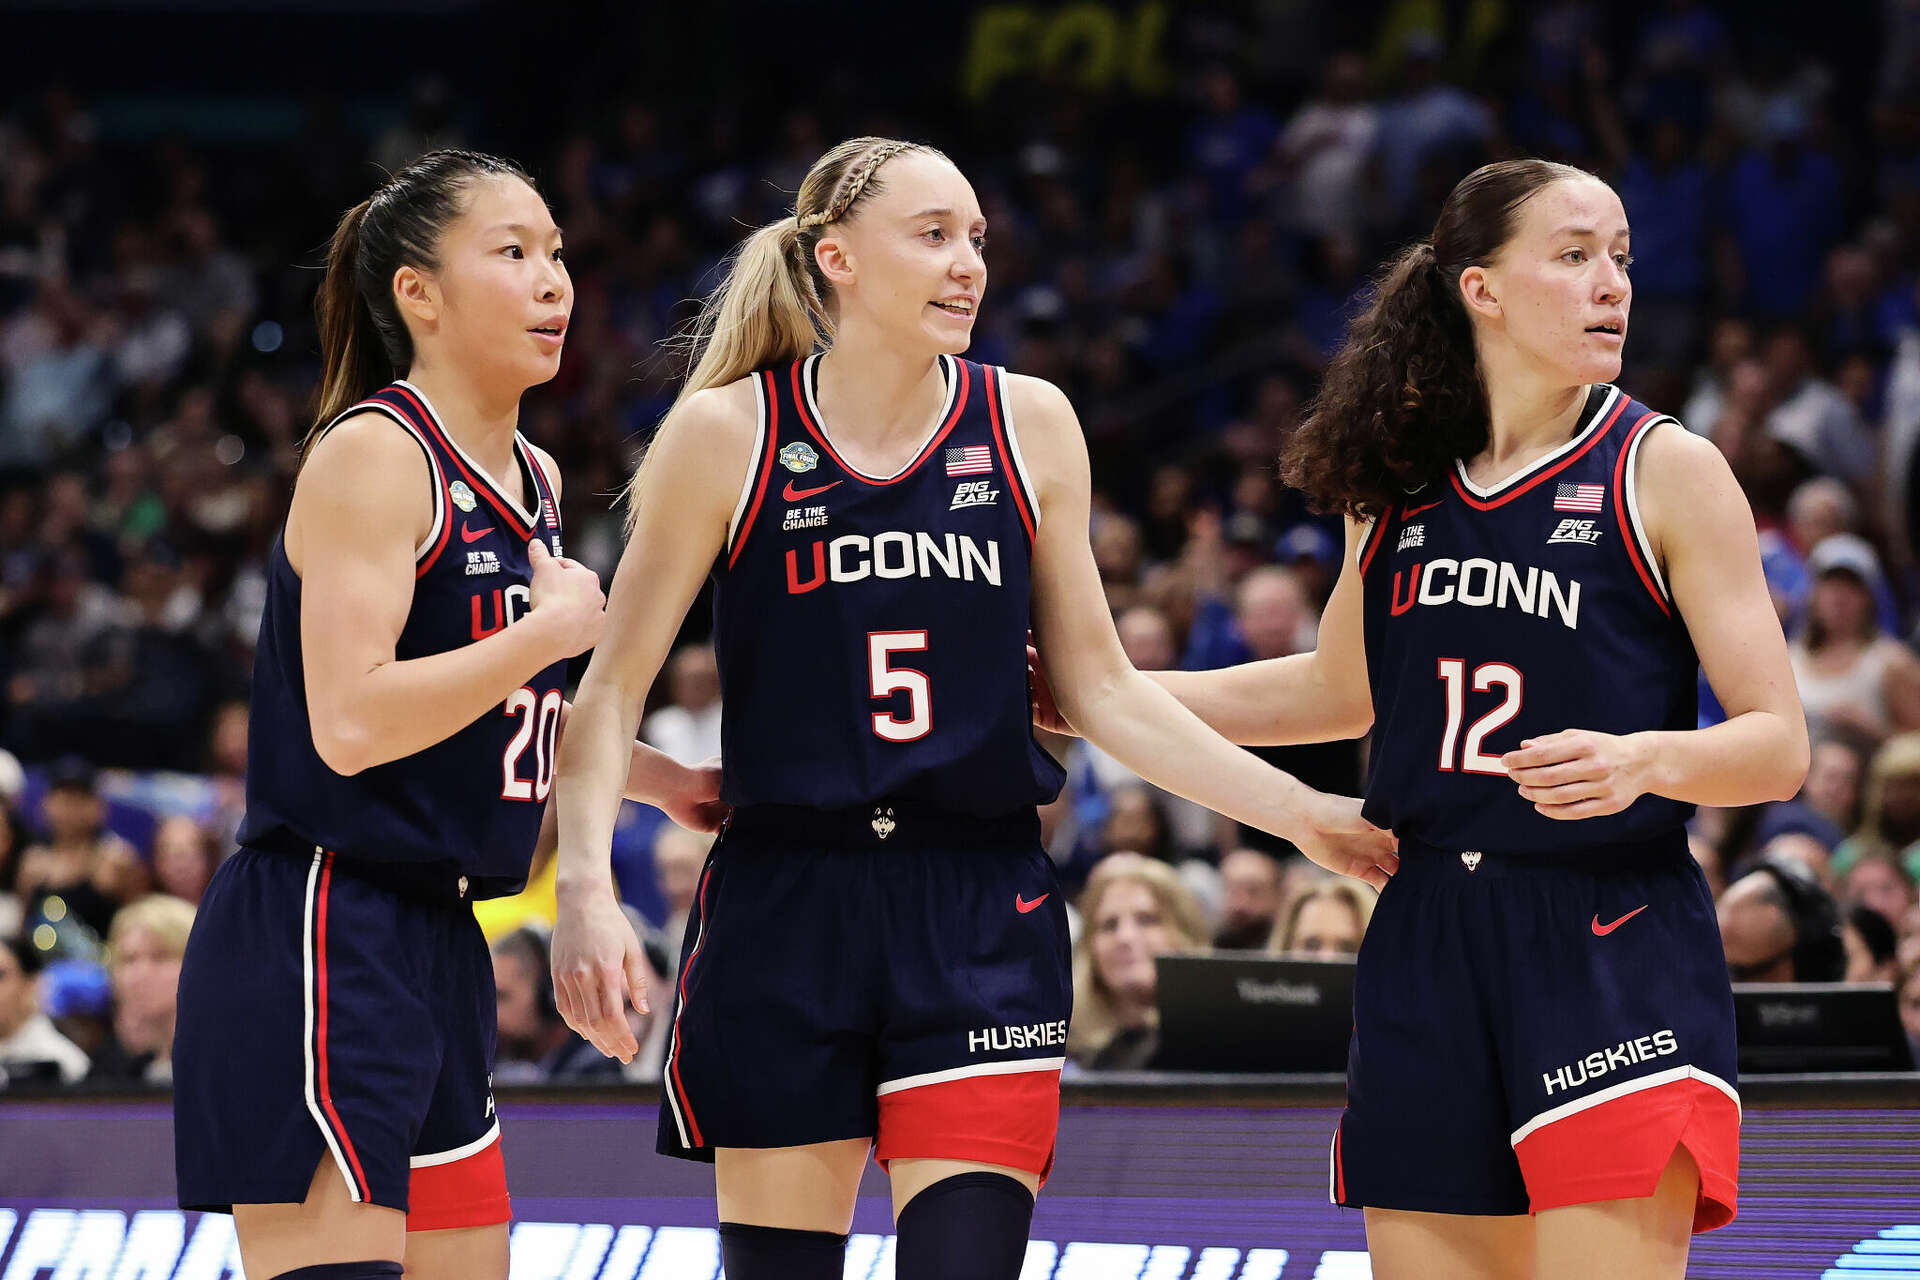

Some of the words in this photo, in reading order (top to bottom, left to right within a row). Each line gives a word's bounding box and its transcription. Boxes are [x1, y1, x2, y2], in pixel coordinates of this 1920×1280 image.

[955, 480, 990, 494] BIG
[952, 490, 1000, 505] EAST
[786, 508, 801, 520] BE
[805, 506, 827, 517] THE
[782, 515, 829, 531] CHANGE
[1557, 519, 1596, 530] BIG
[1407, 525, 1425, 537] THE
[1550, 529, 1603, 541] EAST
[467, 552, 481, 563] BE
[481, 551, 498, 562] THE
[785, 531, 1002, 594] UCONN
[465, 561, 501, 576] CHANGE
[1390, 558, 1581, 629] UCONN
[867, 629, 933, 743] 5
[1437, 657, 1524, 777] 12
[500, 685, 564, 803] 20
[968, 1020, 1066, 1052] HUSKIES
[1542, 1029, 1678, 1095] HUSKIES
